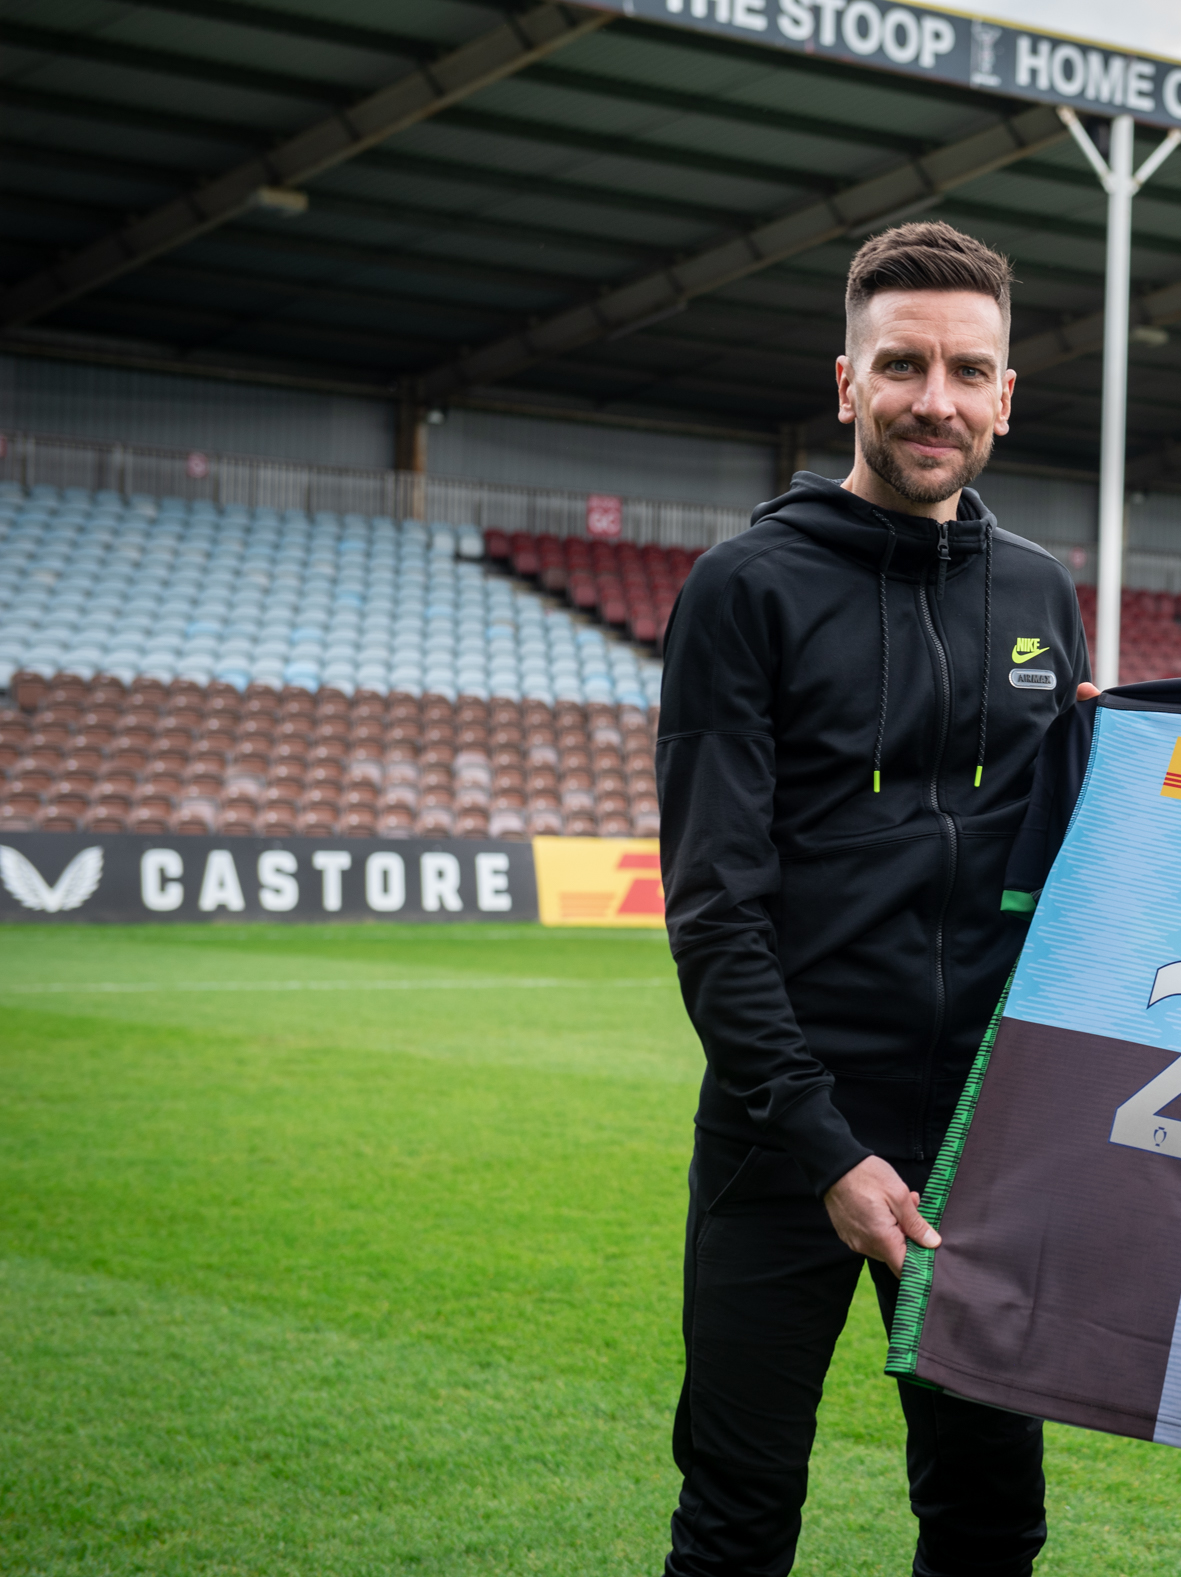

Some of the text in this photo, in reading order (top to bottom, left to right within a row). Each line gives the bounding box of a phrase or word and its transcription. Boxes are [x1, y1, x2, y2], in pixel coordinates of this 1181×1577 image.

[778, 0, 956, 68] STOOP
[1015, 34, 1156, 111] HOME
[1016, 637, 1041, 652] NIKE
[140, 847, 513, 913] CASTORE
